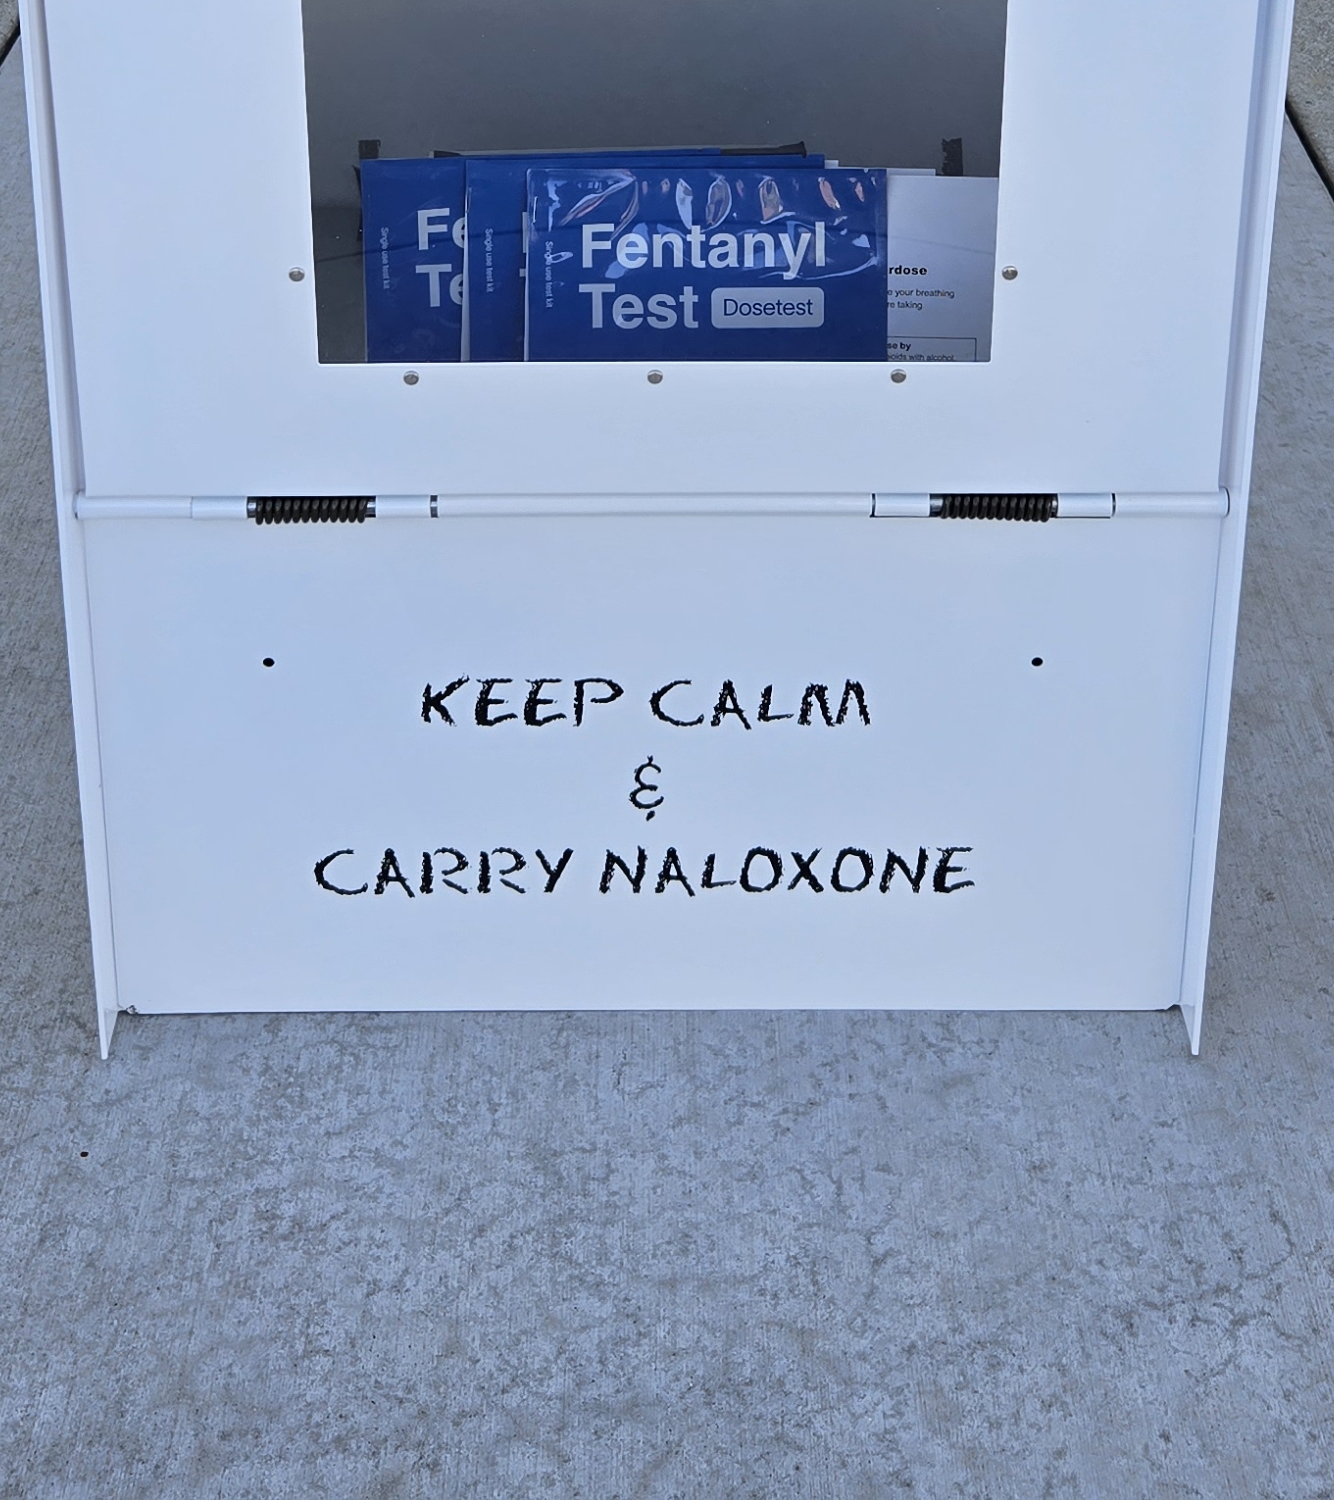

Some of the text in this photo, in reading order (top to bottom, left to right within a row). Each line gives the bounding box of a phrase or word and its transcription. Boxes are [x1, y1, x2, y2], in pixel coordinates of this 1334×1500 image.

[582, 222, 825, 280] Fentanyl
[889, 265, 927, 275] rdose
[579, 283, 813, 329] Test Dosetest
[898, 302, 922, 310] taking
[916, 289, 954, 298] breathing
[421, 674, 871, 730] KEEP CALM
[629, 755, 664, 821] &
[314, 845, 975, 898] CARRY NALOXONE
